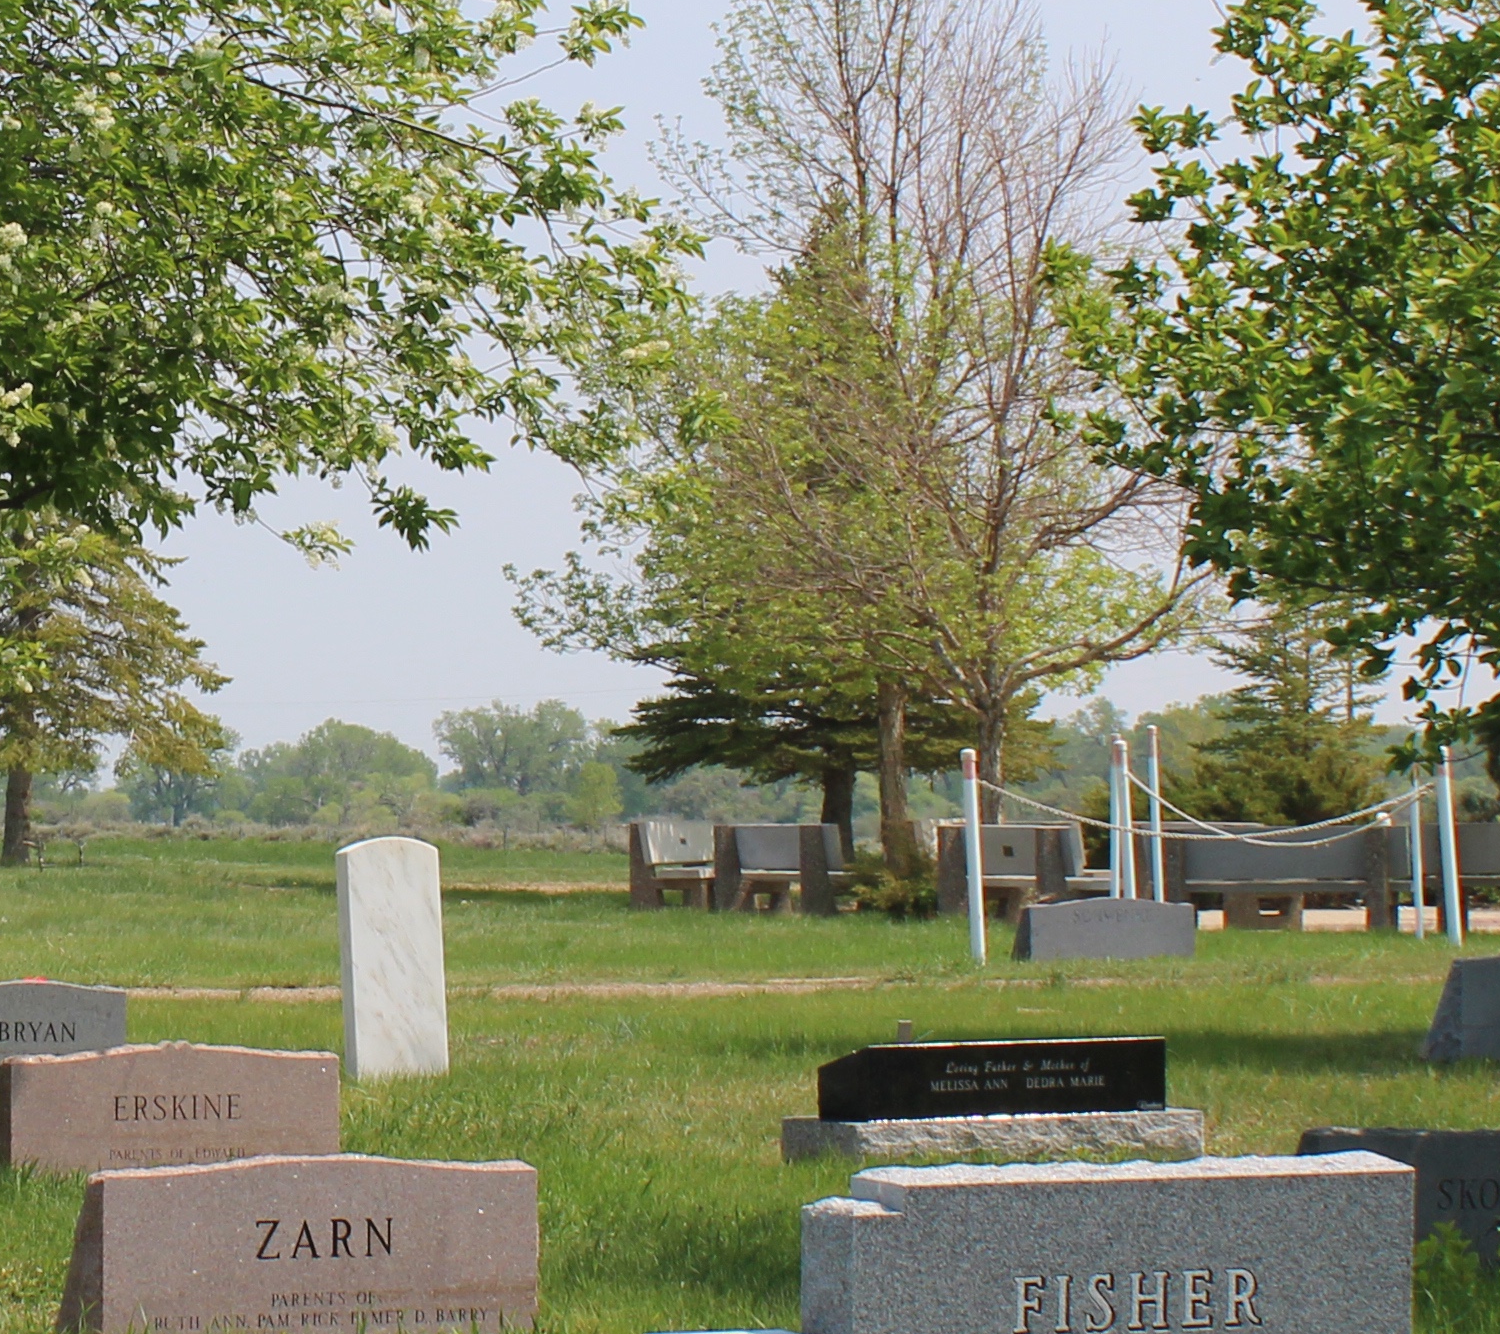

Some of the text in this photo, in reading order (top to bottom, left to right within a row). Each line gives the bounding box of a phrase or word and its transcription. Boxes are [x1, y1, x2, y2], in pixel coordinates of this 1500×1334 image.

[984, 1059, 1017, 1074] Father
[1022, 1059, 1034, 1072] &
[1040, 1058, 1076, 1072] Mother
[1080, 1057, 1091, 1073] of
[929, 1075, 1106, 1092] MELISSA ANN DEDRA MARIE
[112, 1093, 243, 1122] ERSKINE
[108, 1147, 163, 1161] PARENTS
[169, 1148, 184, 1159] OF
[255, 1217, 394, 1261] ZARN
[271, 1291, 346, 1308] PARENTS
[154, 1315, 200, 1331] RUTH
[436, 1307, 488, 1323] BARRY
